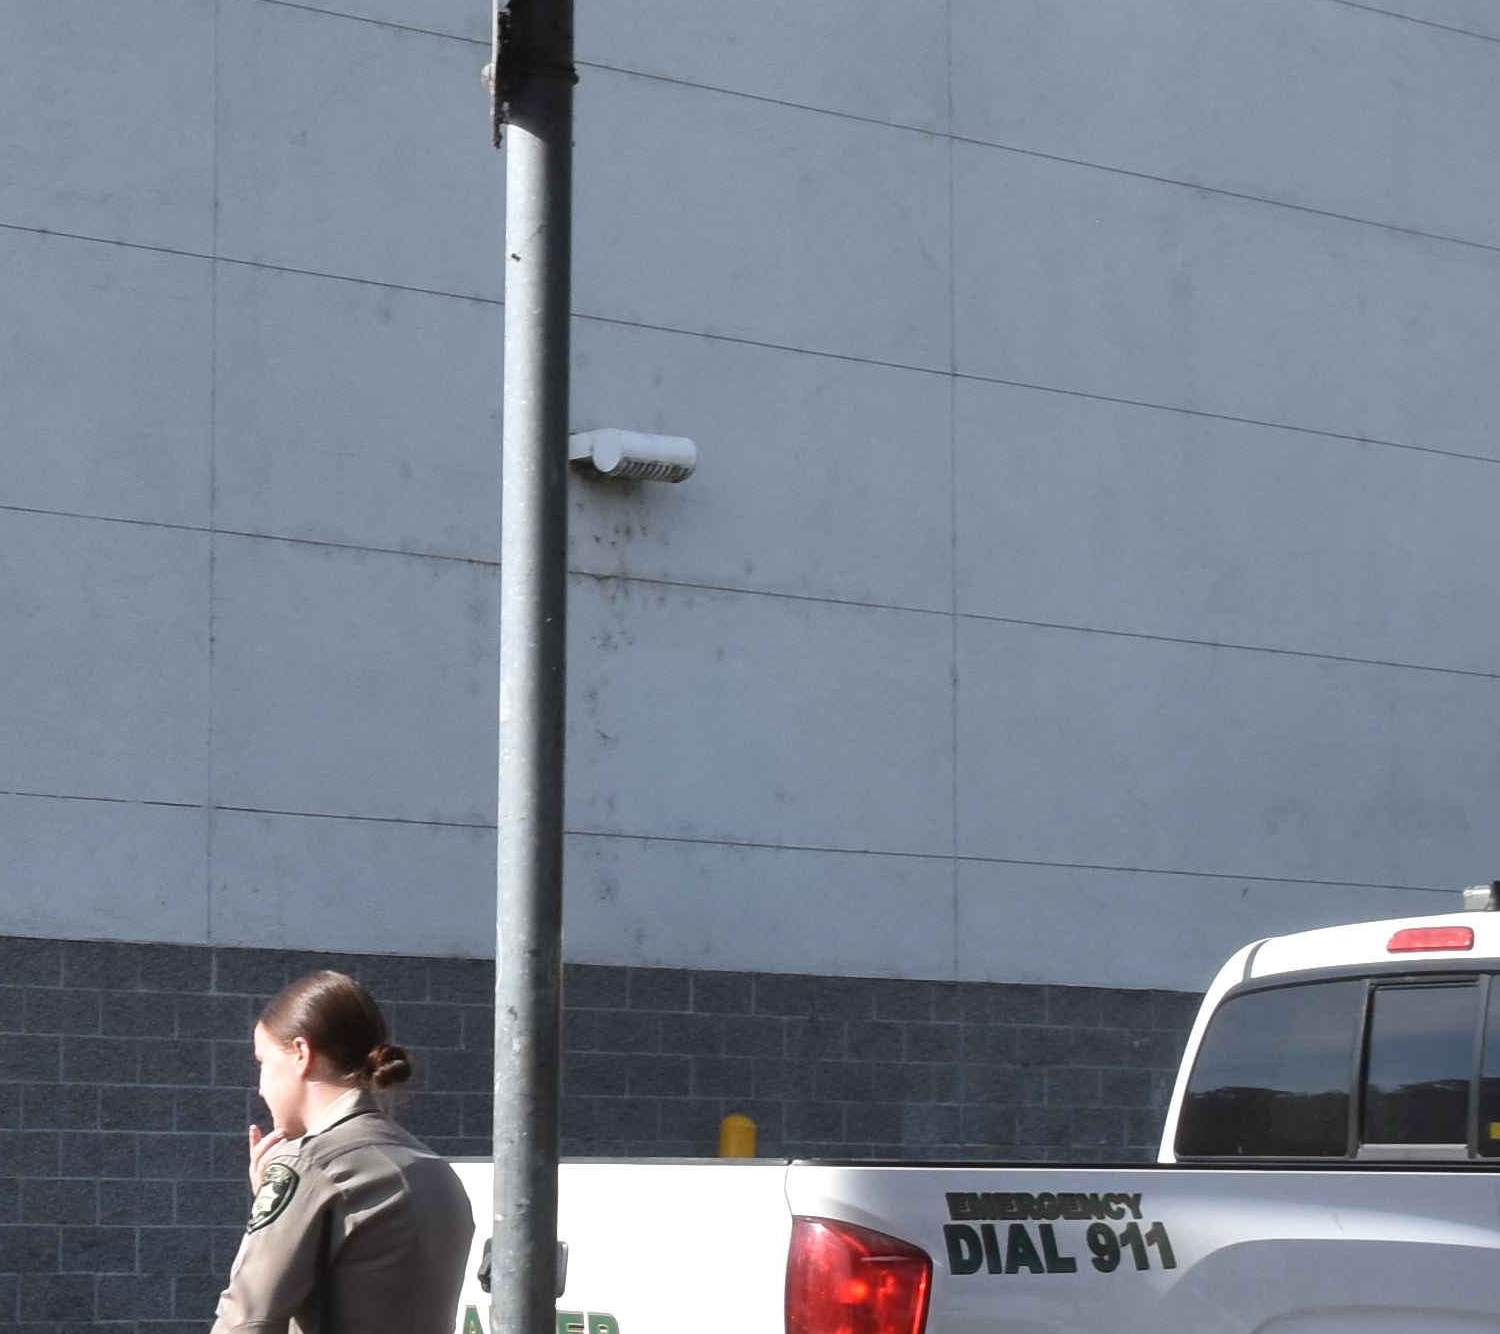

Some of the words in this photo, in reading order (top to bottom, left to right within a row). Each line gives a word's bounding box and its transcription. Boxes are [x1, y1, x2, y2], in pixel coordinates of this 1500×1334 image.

[945, 1192, 1144, 1221] EMERGENCY
[943, 1223, 1078, 1275] DIAL
[1086, 1221, 1178, 1273] 911
